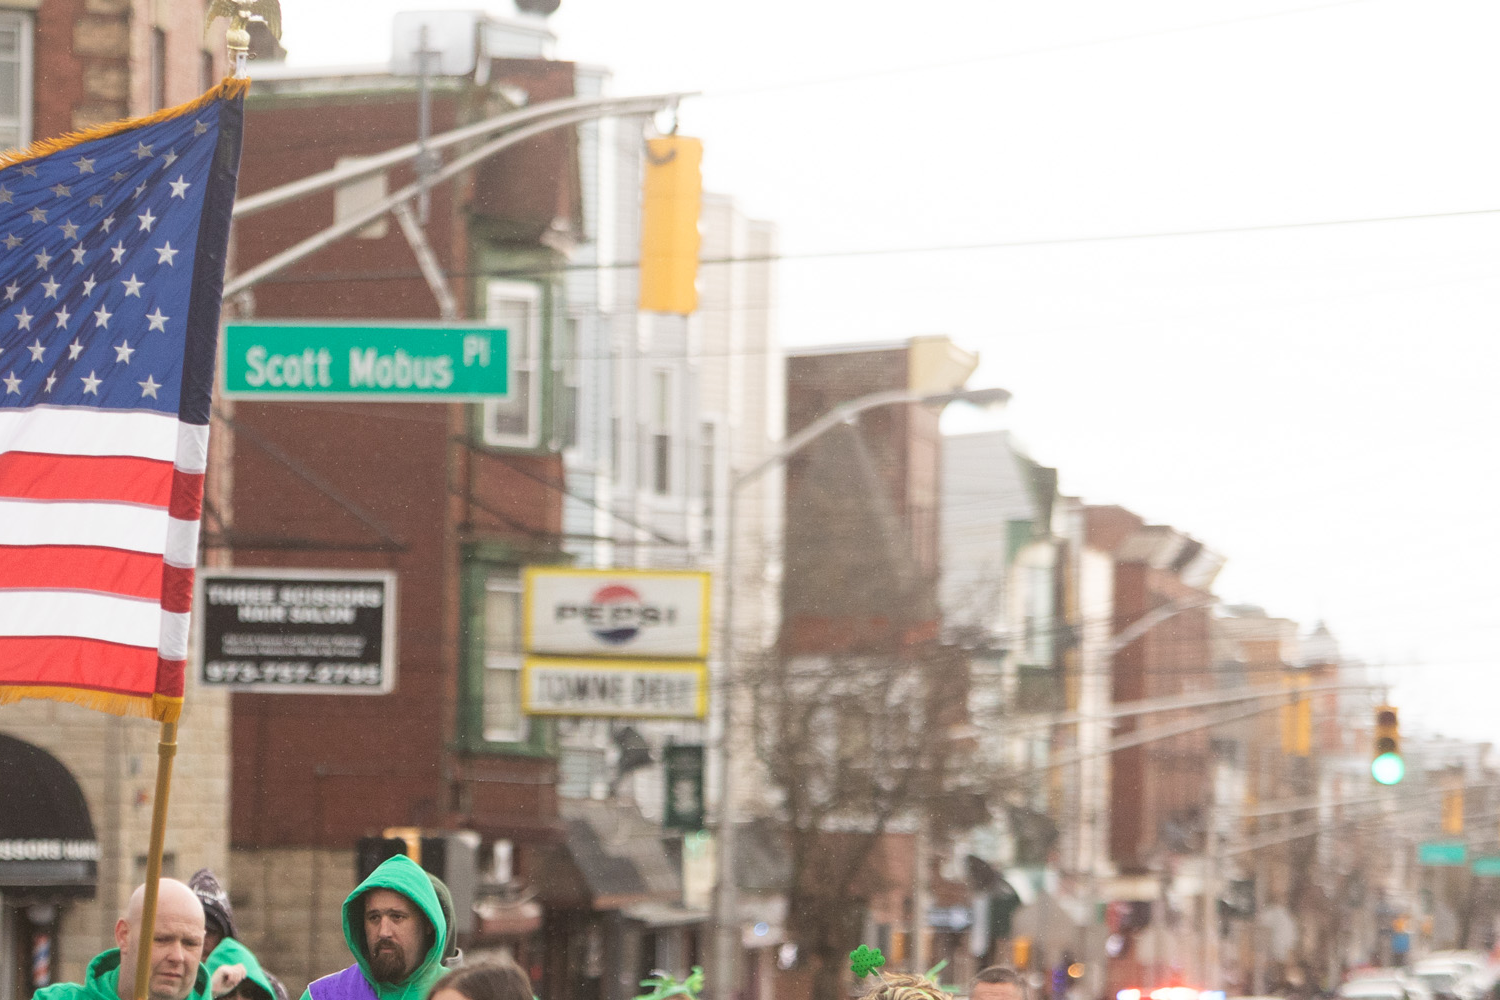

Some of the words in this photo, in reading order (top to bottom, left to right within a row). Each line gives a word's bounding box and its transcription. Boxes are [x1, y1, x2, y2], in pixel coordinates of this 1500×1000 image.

[245, 345, 333, 388] Scott
[349, 346, 454, 389] Mobus
[555, 606, 678, 626] PEPSI
